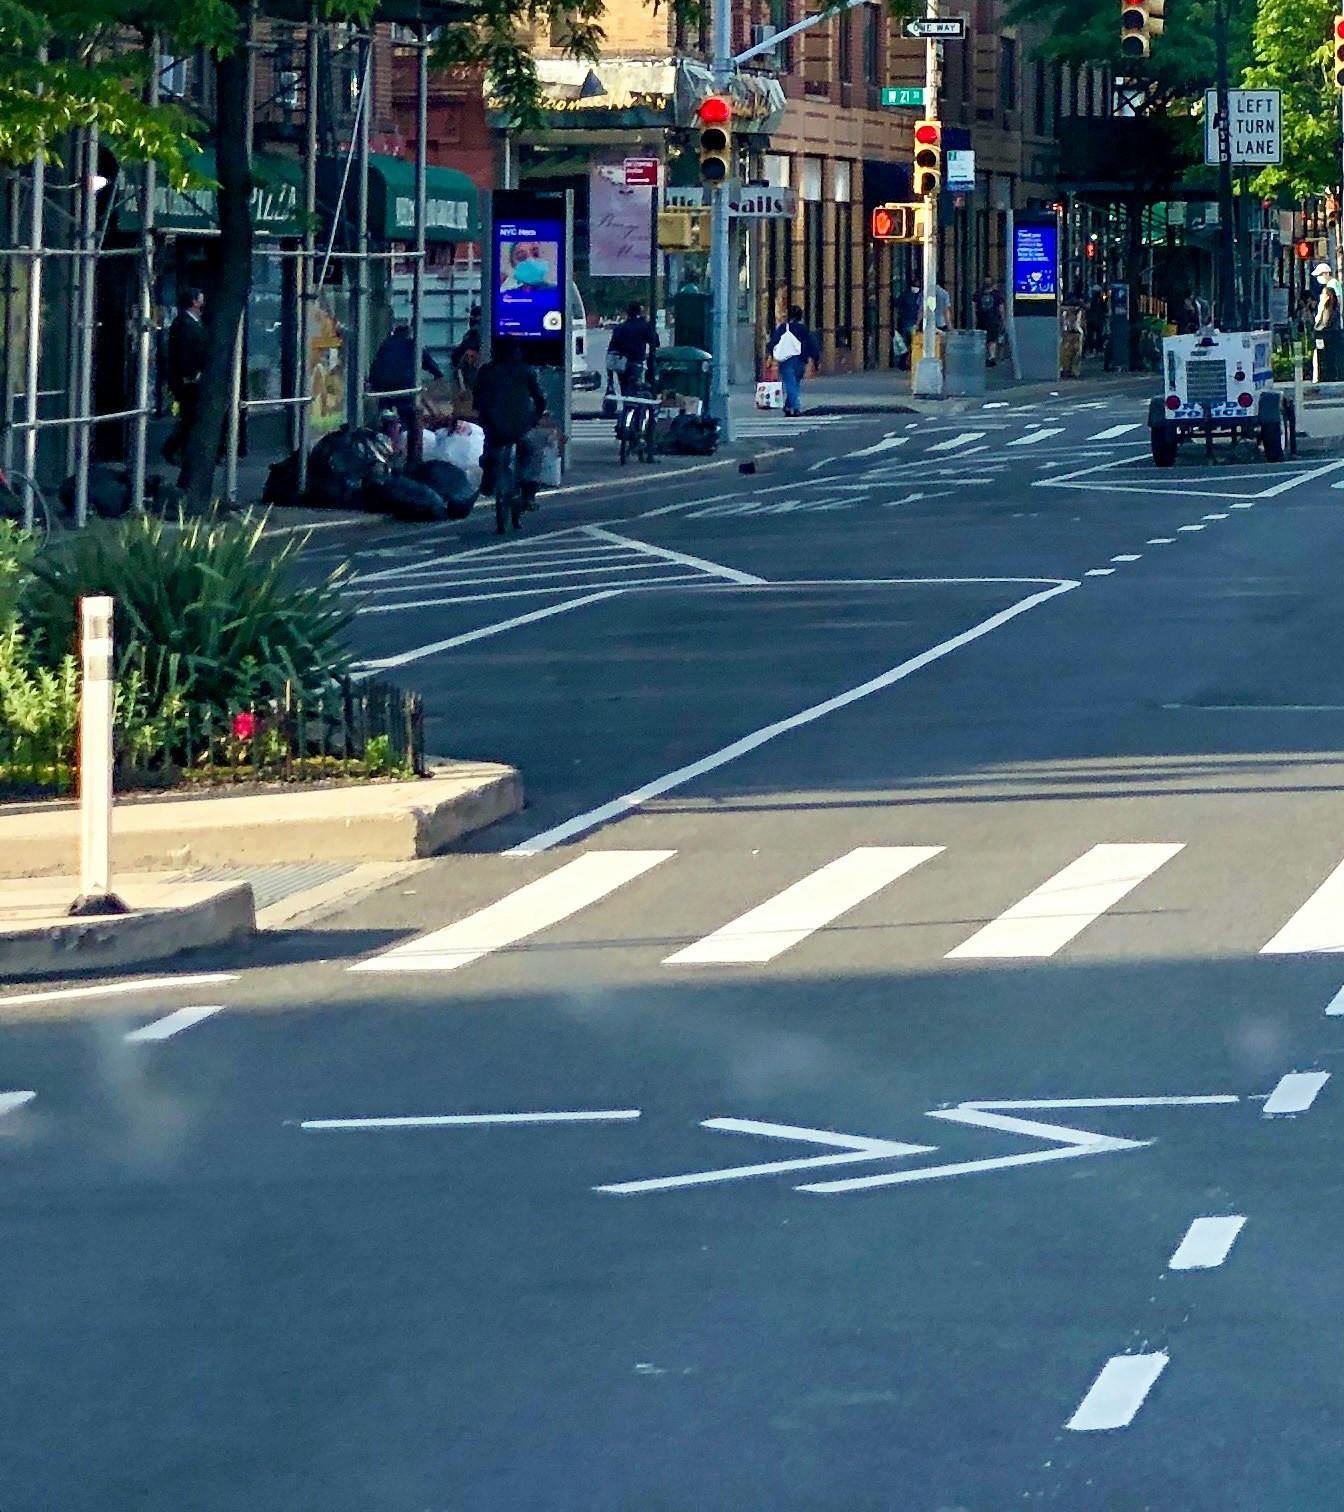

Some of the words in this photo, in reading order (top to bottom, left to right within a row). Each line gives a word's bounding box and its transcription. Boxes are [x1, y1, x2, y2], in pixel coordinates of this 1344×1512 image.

[936, 23, 956, 32] WAY
[888, 91, 897, 103] W
[900, 90, 910, 104] 21
[1237, 98, 1273, 113] LEFT
[1236, 119, 1275, 134] TURN
[1236, 140, 1275, 155] LANE
[1183, 401, 1238, 410] NPD
[1174, 408, 1248, 419] POICE
